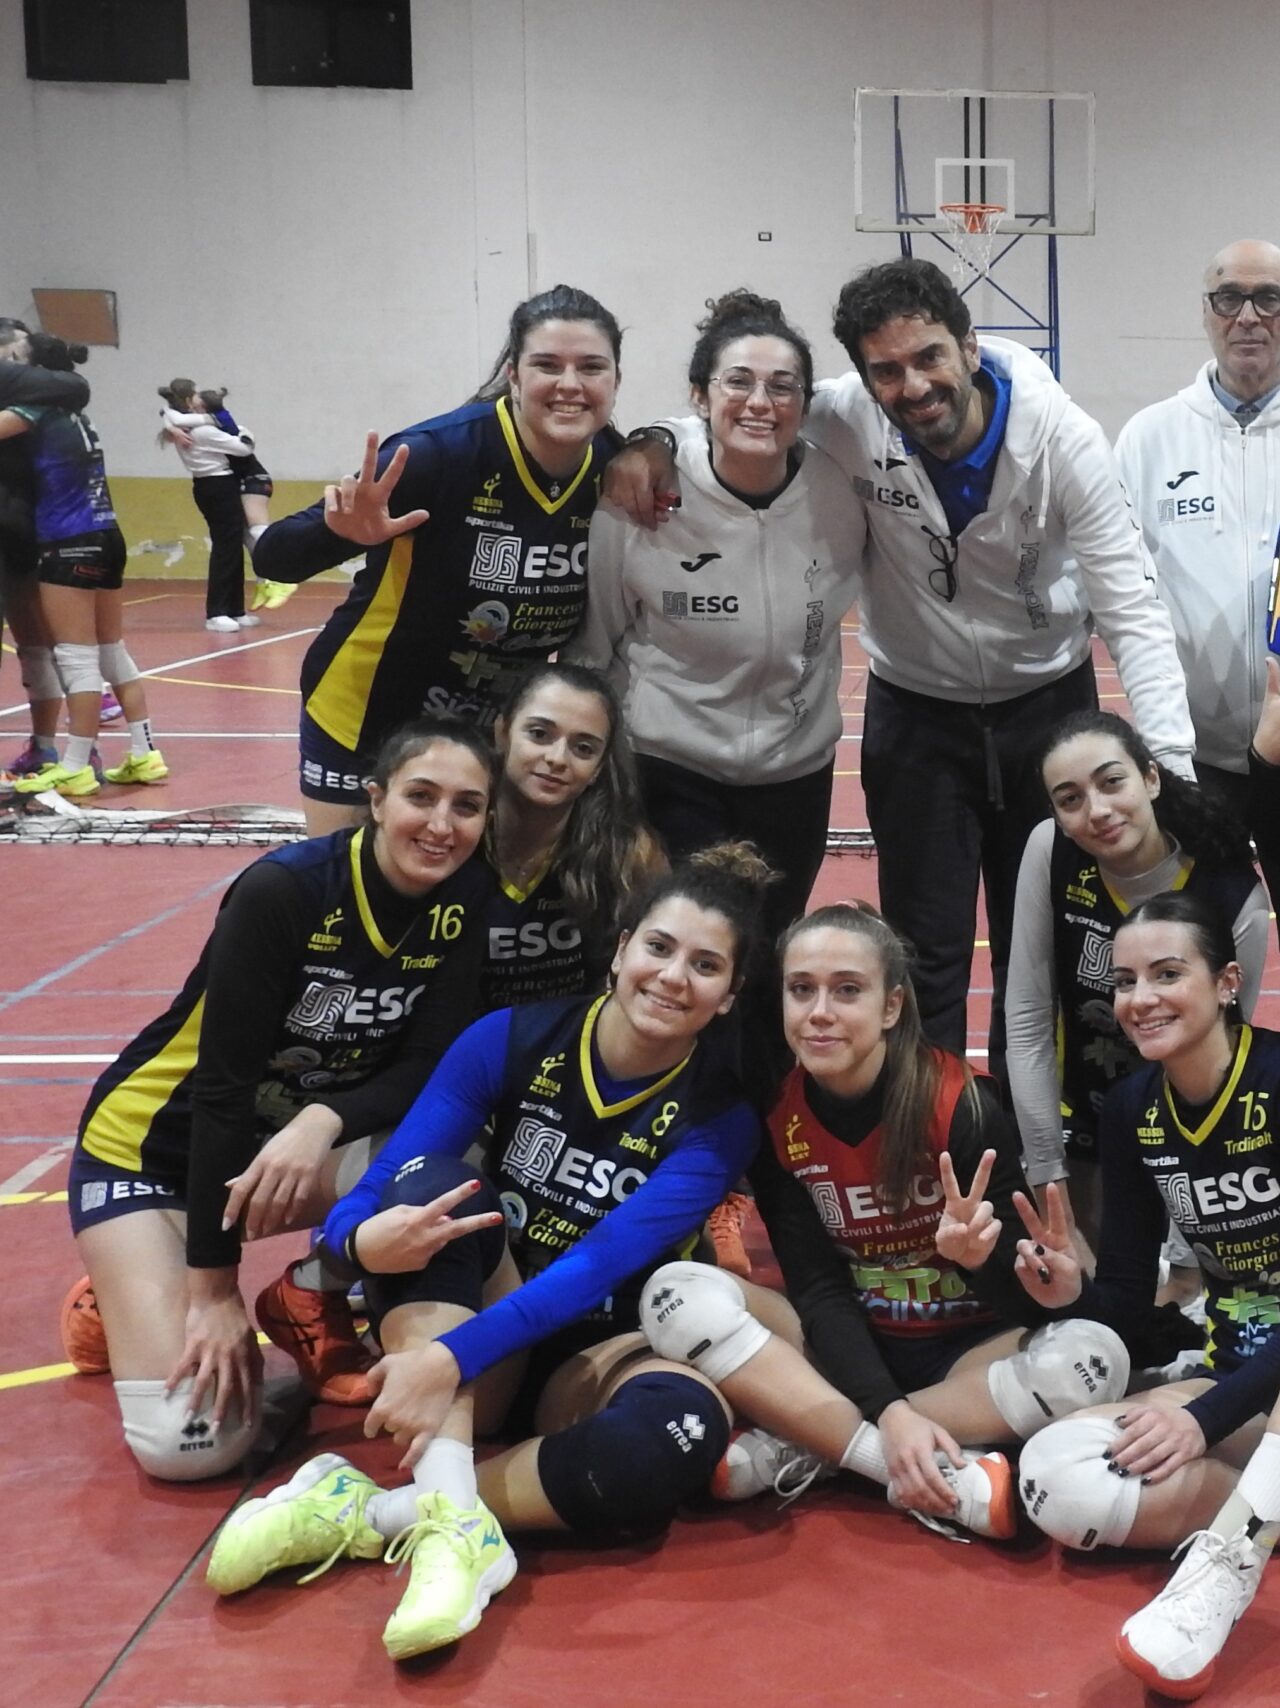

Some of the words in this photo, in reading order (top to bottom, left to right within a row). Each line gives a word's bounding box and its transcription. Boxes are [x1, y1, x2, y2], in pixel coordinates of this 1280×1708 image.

[877, 487, 920, 510] ESG
[1177, 496, 1215, 516] ESG
[691, 595, 739, 614] ESG
[428, 904, 465, 941] 16
[489, 919, 582, 960] ESG
[1077, 977, 1112, 995] PULIZIE
[652, 1101, 679, 1137] 8
[532, 1183, 564, 1203] CIVILI
[565, 1196, 574, 1206] E
[574, 1200, 612, 1219] INDUST
[841, 1225, 873, 1238] CIVILI
[875, 1225, 883, 1234] E
[1222, 1221, 1229, 1232] E
